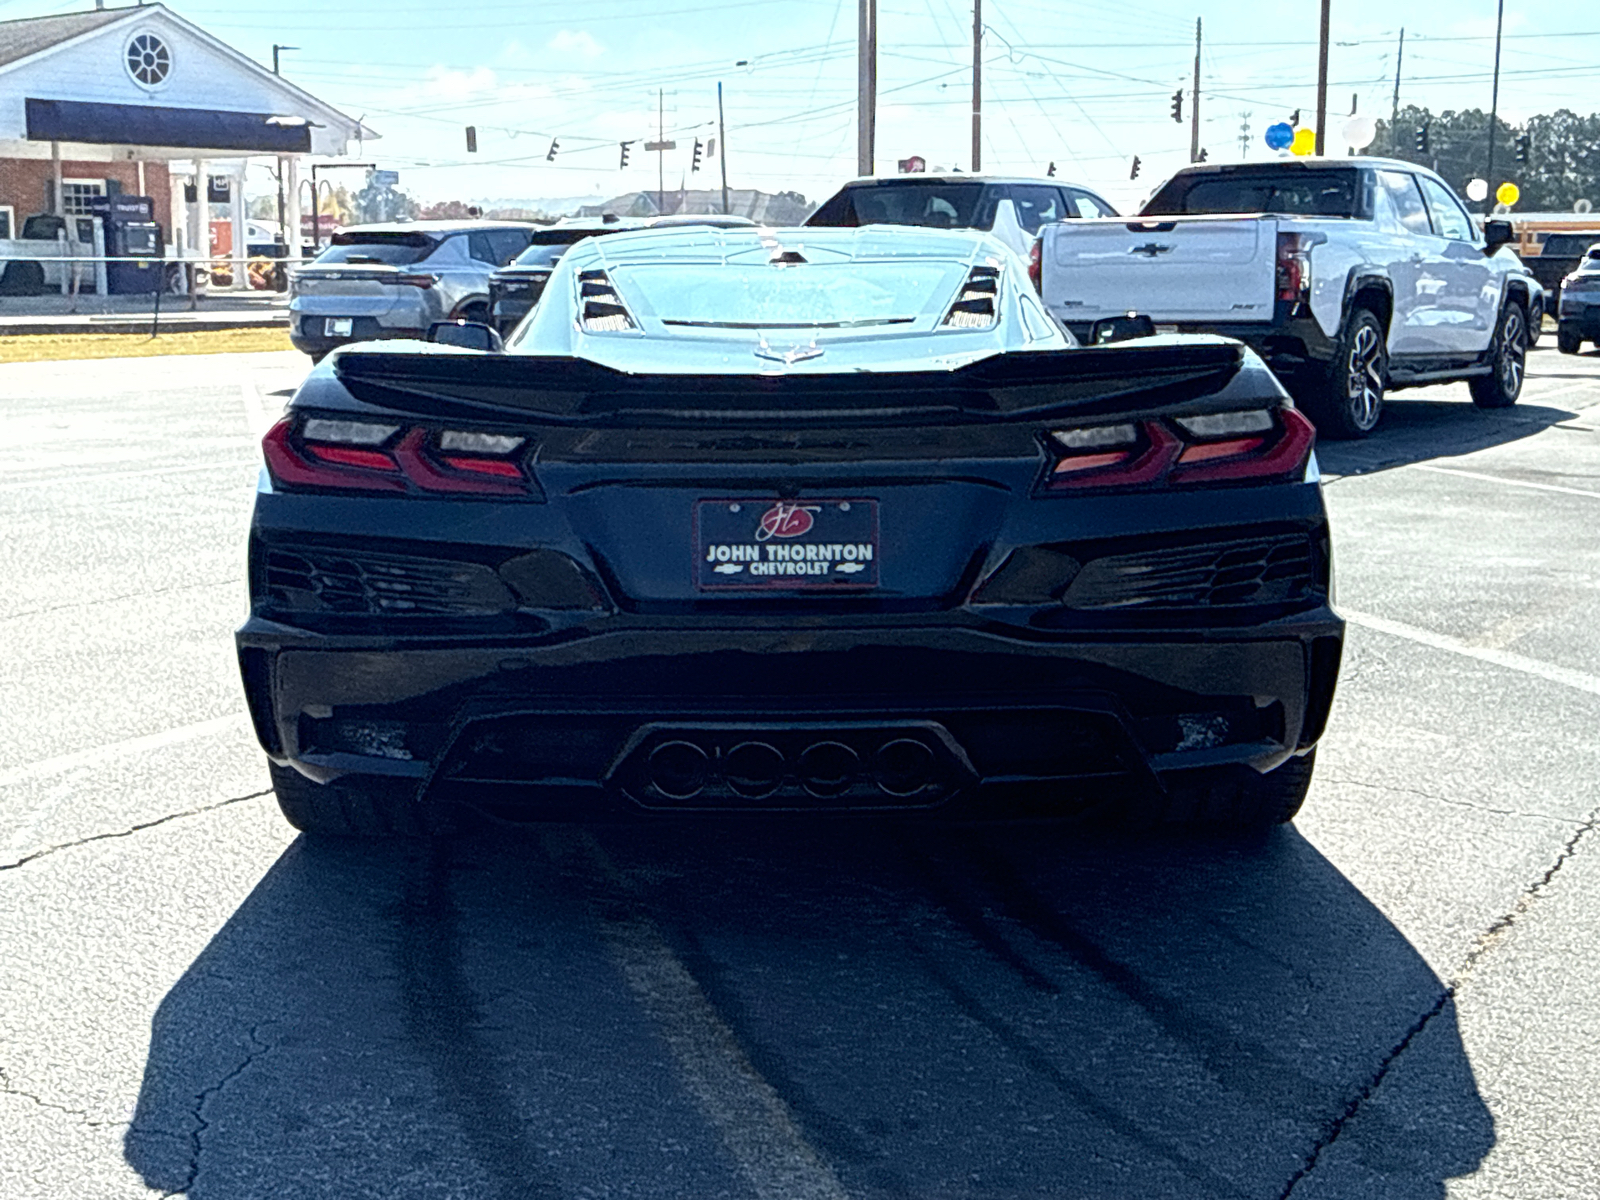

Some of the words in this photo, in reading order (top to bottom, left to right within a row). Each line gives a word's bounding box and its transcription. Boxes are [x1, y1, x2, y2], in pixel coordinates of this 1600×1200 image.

[706, 544, 760, 562] JOHN
[765, 544, 873, 561] THORNTON
[750, 562, 830, 576] CHEVROLET
